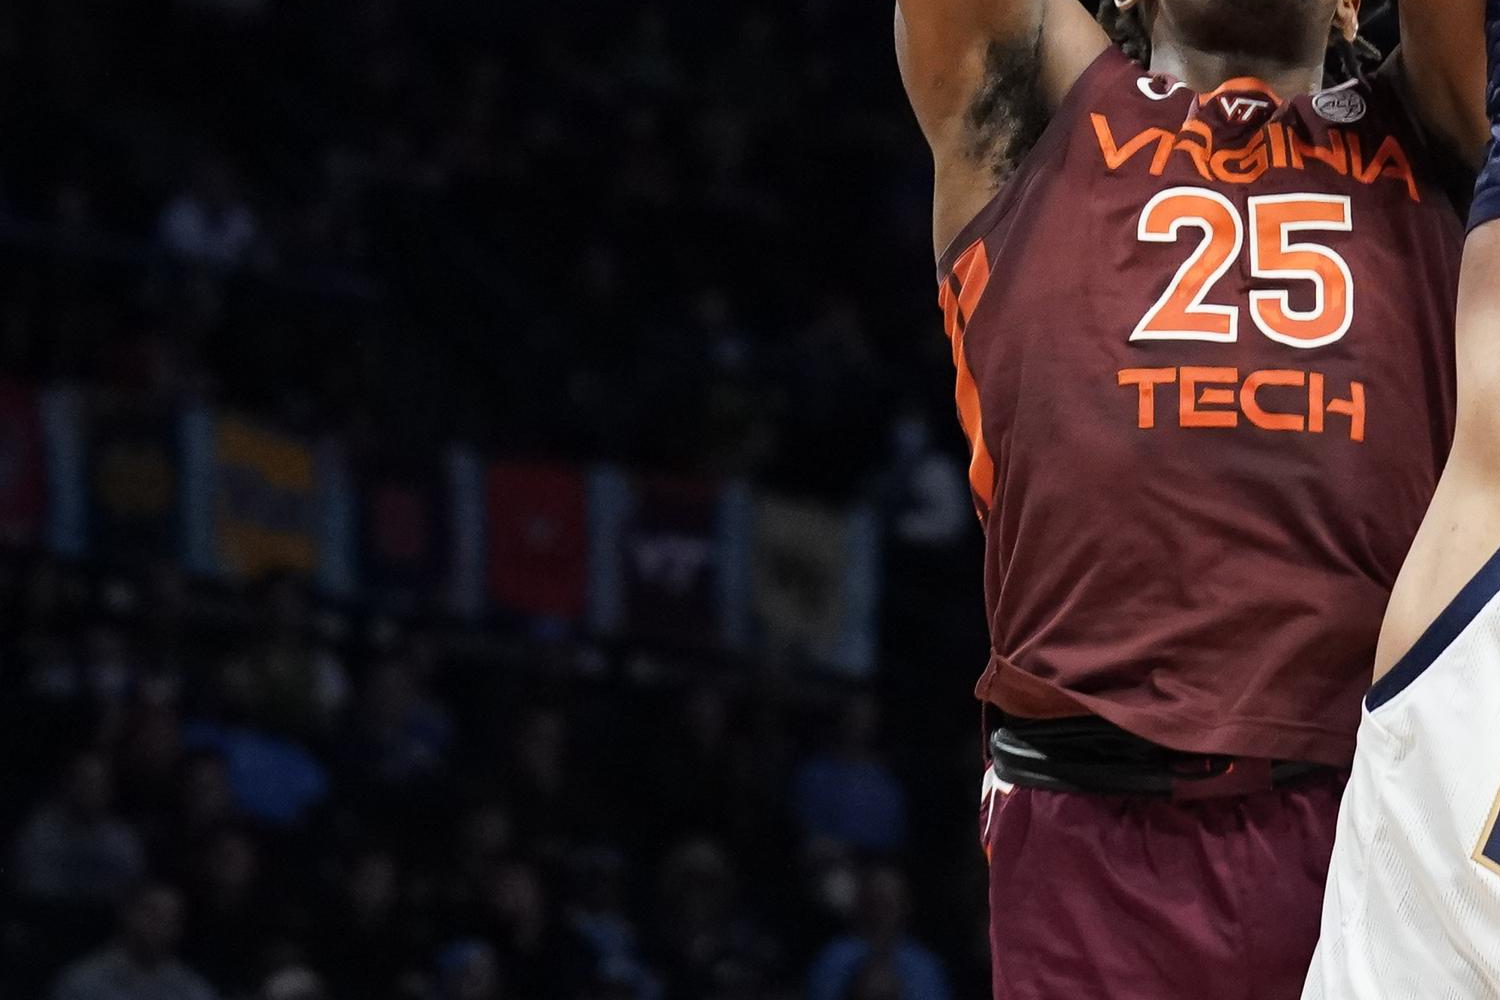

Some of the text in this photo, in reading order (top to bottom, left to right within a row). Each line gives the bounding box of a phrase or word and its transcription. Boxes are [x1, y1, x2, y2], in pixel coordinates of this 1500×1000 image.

[1220, 96, 1268, 121] VT
[1090, 112, 1421, 203] VIRGINIA
[1130, 187, 1353, 348] 25
[1118, 366, 1366, 443] TECH
